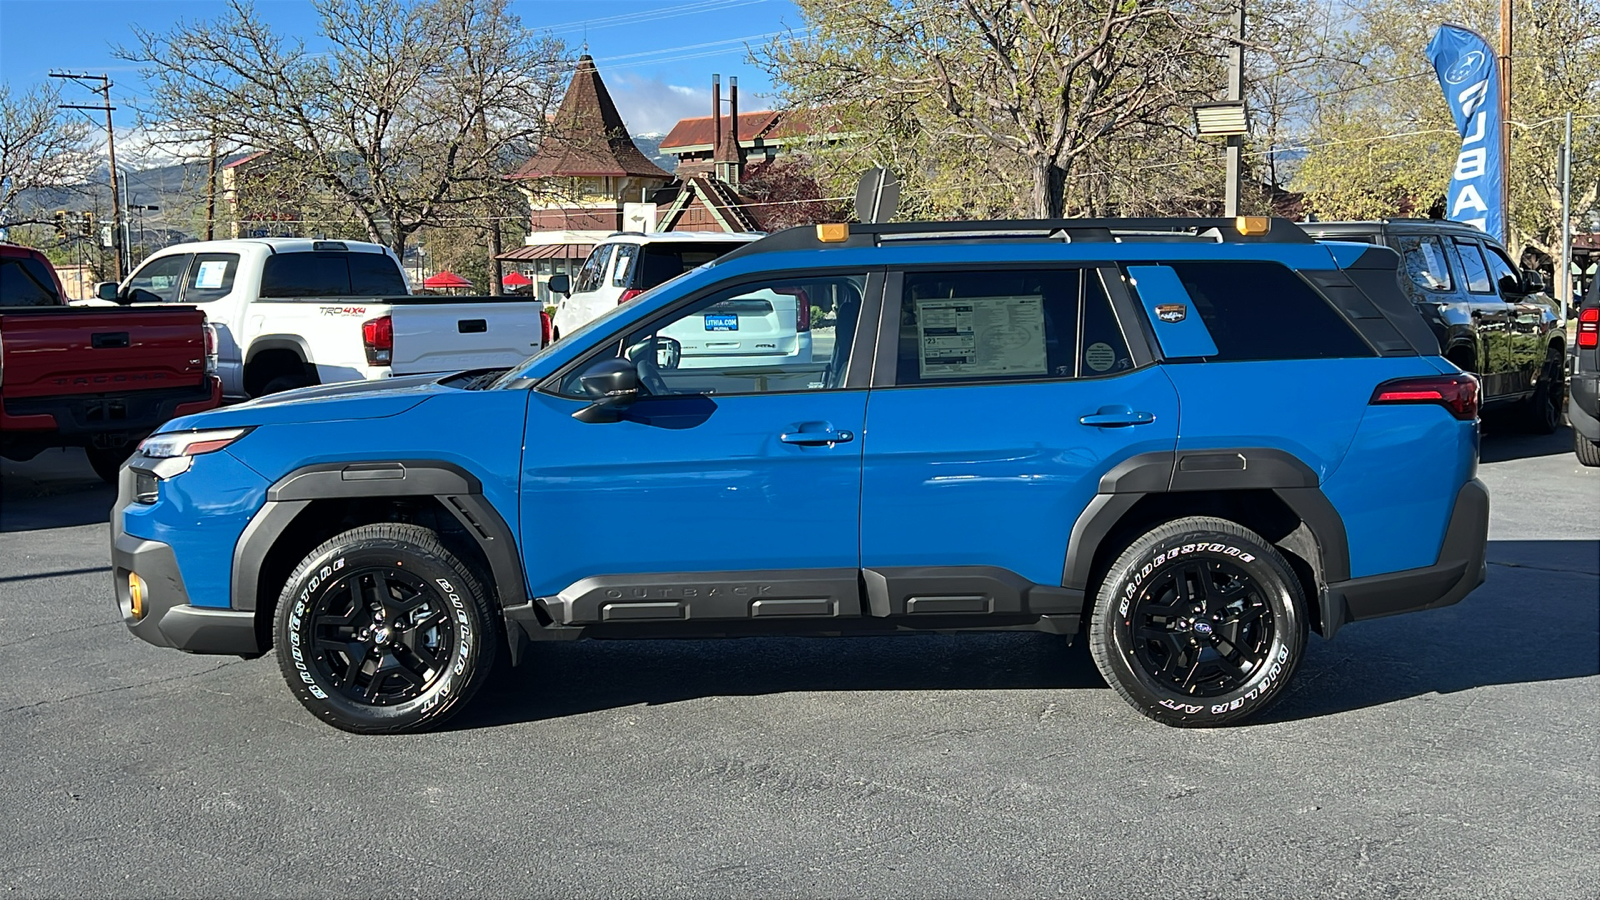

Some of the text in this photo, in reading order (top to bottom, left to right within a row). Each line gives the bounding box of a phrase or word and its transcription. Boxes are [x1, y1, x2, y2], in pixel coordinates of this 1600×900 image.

[52, 372, 167, 386] TACOMA
[605, 585, 772, 600] OUTBACK
[1118, 542, 1256, 618] BRIDGESTONE
[289, 557, 345, 700] BRIDGESTONE
[436, 578, 470, 676] DUELER
[1159, 643, 1289, 715] DUELER A/T
